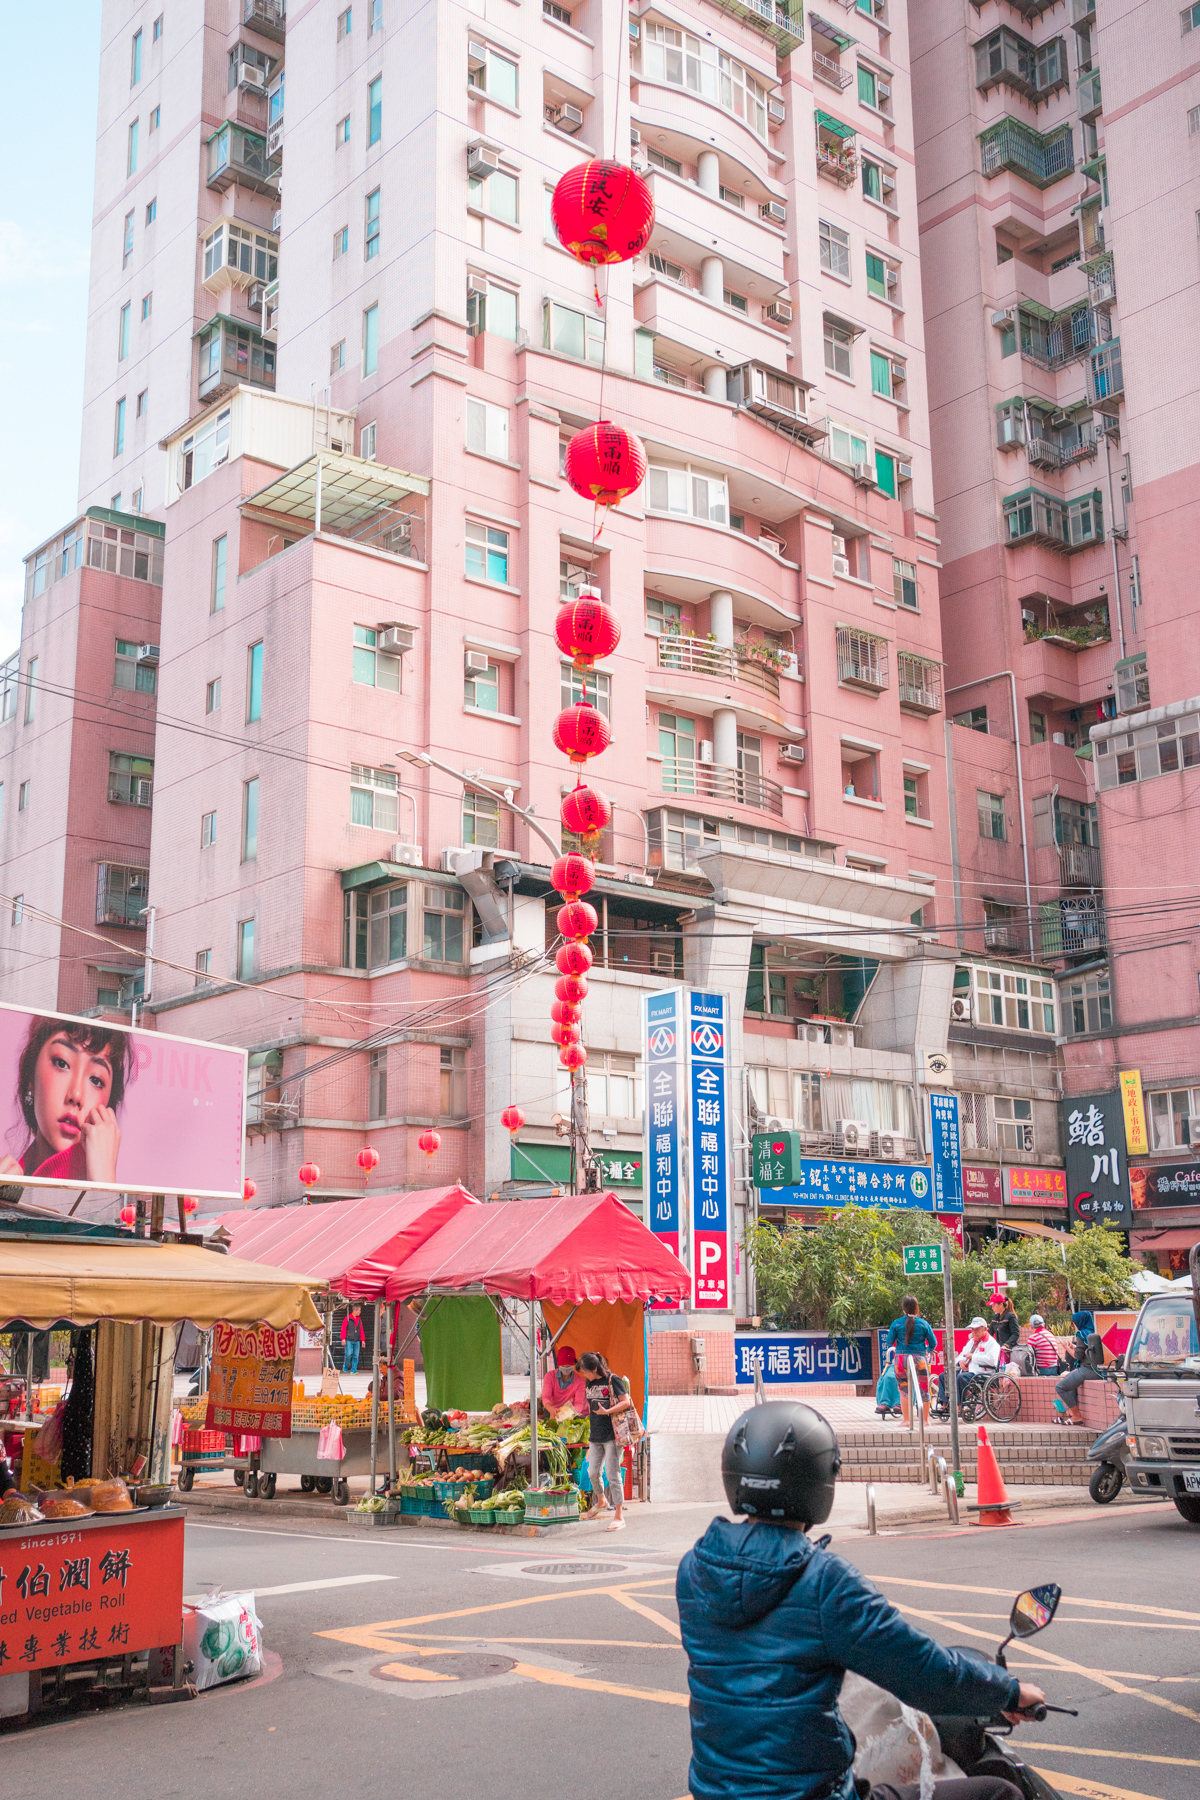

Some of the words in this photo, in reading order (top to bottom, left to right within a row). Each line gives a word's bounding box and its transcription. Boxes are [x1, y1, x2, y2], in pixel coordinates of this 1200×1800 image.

[658, 1007, 673, 1016] MART
[703, 1006, 720, 1015] MART
[132, 1042, 213, 1093] PINK
[1127, 1089, 1141, 1145] 地政士事務所
[652, 1070, 674, 1221] 全聯福利中心
[696, 1068, 721, 1219] 全聯福利中心
[758, 1139, 771, 1160] 清
[941, 1122, 950, 1159] 醫學中心
[759, 1160, 786, 1181] 福全
[857, 1171, 906, 1191] 聯合診所
[1081, 1200, 1125, 1213] 四季鍋物
[700, 1241, 722, 1275] P
[908, 1249, 938, 1259] 民族路
[914, 1260, 938, 1271] 29巷
[697, 1279, 725, 1290] 停車場
[735, 1345, 862, 1377] 聯福利中心
[25, 1599, 92, 1622] Vegetable
[100, 1593, 125, 1609] Roll
